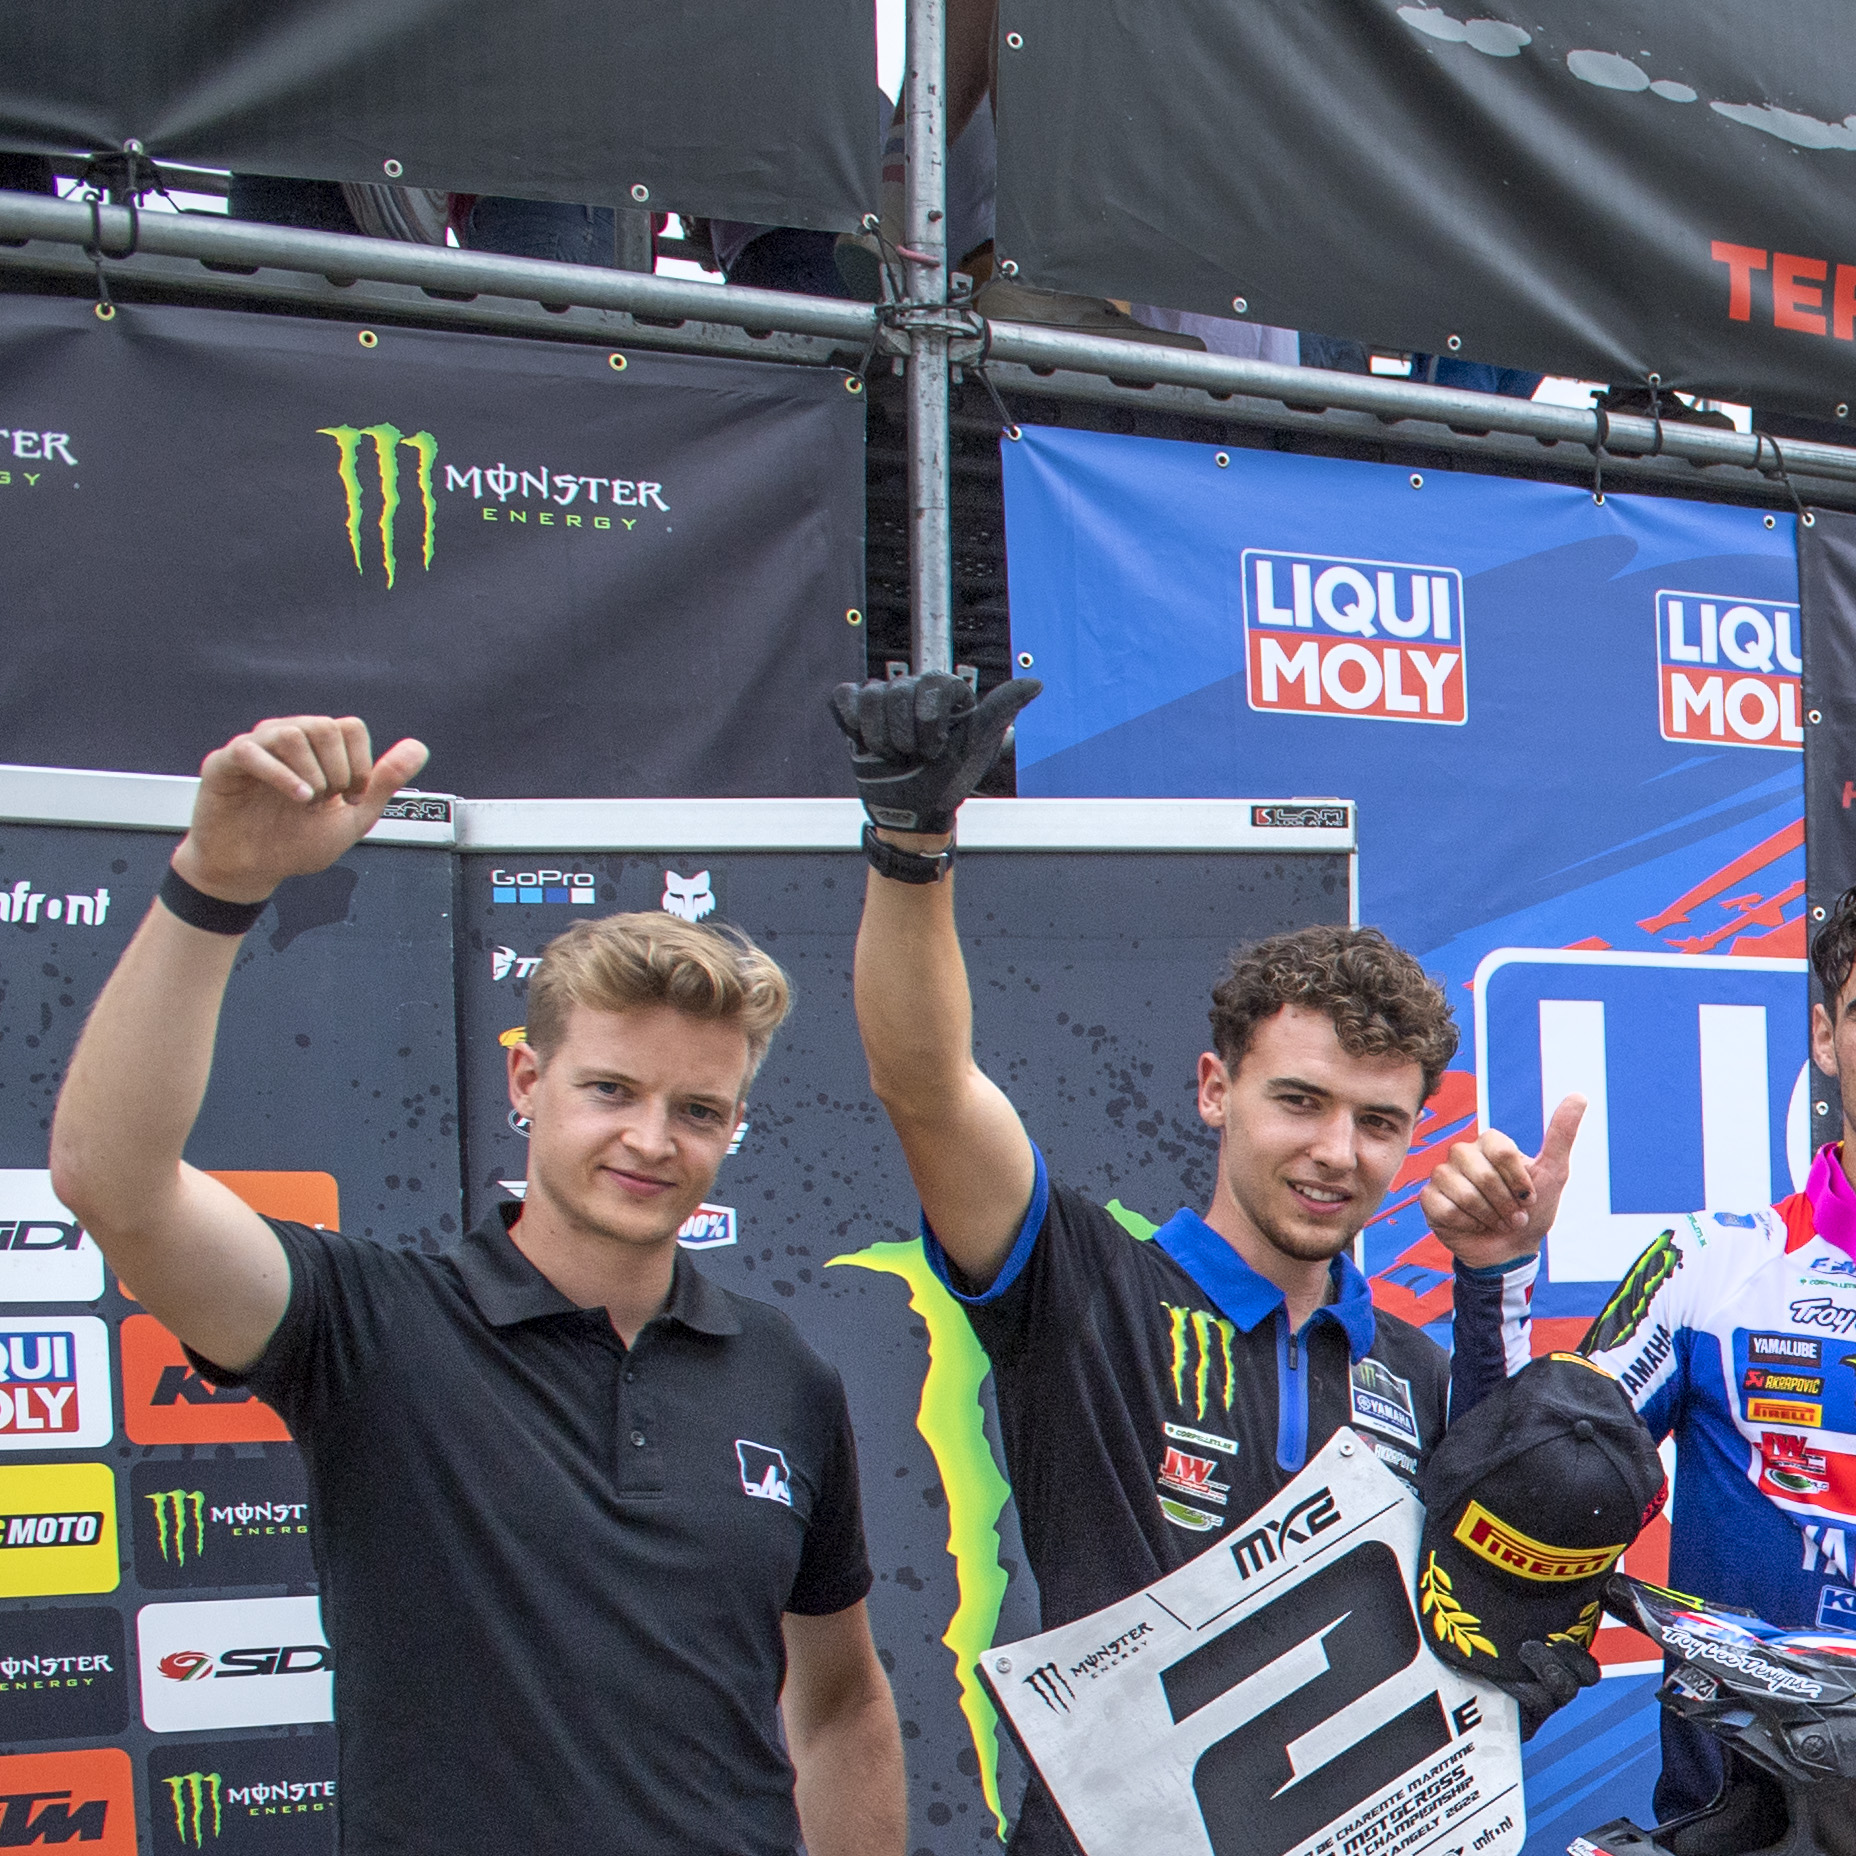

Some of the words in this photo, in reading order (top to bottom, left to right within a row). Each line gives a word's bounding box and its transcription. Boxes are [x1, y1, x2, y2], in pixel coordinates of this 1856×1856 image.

[444, 462, 670, 512] MONSTER
[483, 508, 637, 531] ENERGY
[1255, 560, 1451, 641] LIQUI
[1670, 602, 1802, 673] LIQU
[1259, 641, 1459, 716] MOLY
[1672, 675, 1804, 741] MOL
[491, 870, 594, 885] GoPro
[1790, 1299, 1855, 1333] Troy
[1621, 1324, 1673, 1394] AMAHA
[1753, 1338, 1817, 1359] YAMALUBE
[1371, 1400, 1411, 1427] YAMAHA
[1752, 1404, 1814, 1422] PIRELLI
[1230, 1487, 1341, 1580] MX2
[1470, 1517, 1610, 1578] PIRELLI
[0, 1656, 112, 1678] ONSTER
[1091, 1640, 1148, 1679] ENERGY
[1452, 1696, 1484, 1736] E
[1317, 1837, 1334, 1852] DE
[1336, 1789, 1405, 1840] CHARENTE
[1408, 1742, 1475, 1793] MARITIME
[1343, 1765, 1466, 1855] MOTOCROSS
[1365, 1776, 1474, 1856] CHAMPIONSHIP
[1446, 1790, 1481, 1818] 2022
